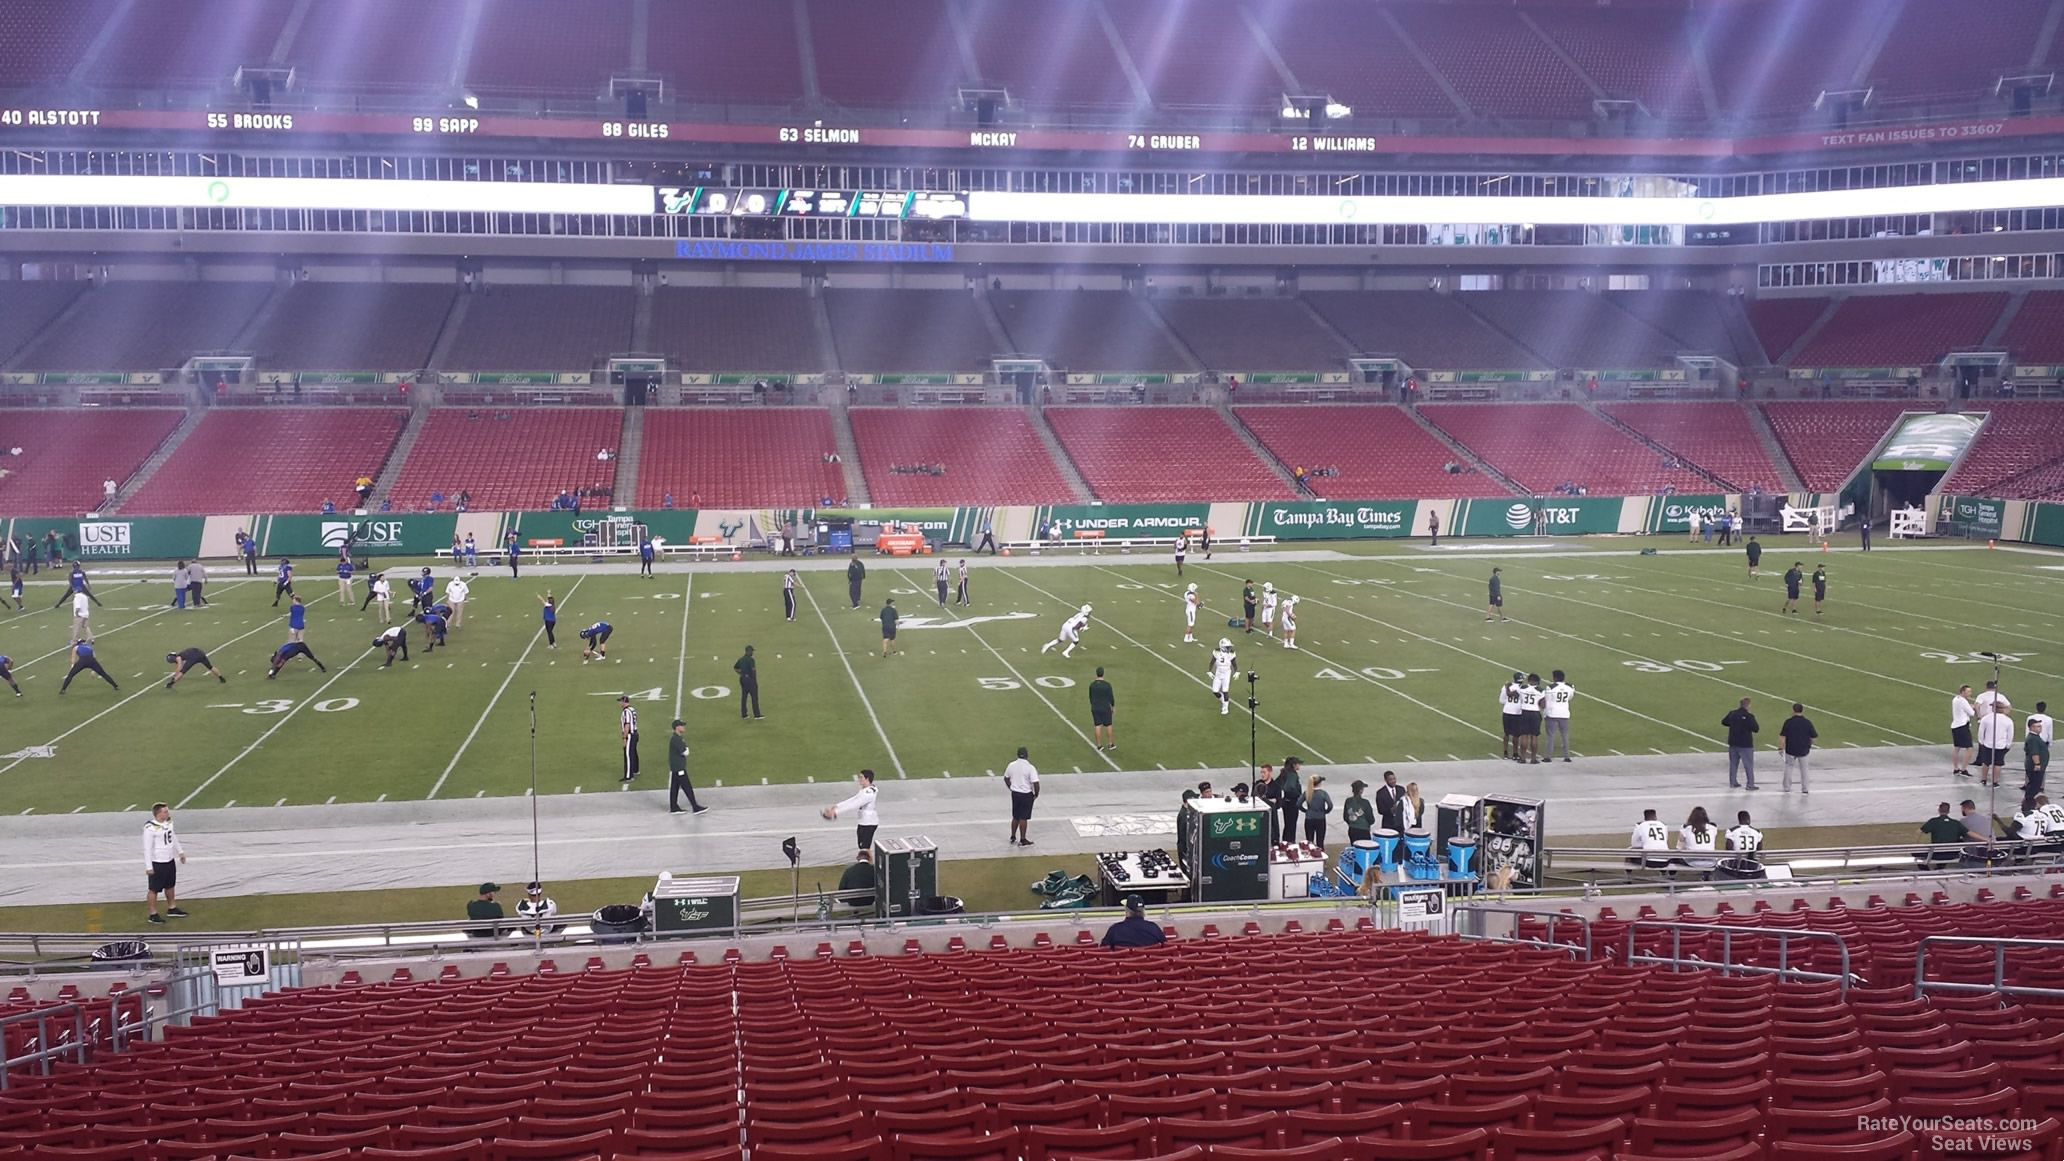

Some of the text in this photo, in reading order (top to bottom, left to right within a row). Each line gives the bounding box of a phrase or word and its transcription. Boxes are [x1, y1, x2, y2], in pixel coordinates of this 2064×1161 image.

[1, 110, 100, 125] 40 ALSTOTT
[207, 113, 293, 129] 55 BROOKS
[413, 118, 478, 133] 99 SAPP
[602, 122, 669, 138] 88 GILES
[780, 128, 859, 143] 63 SELMON
[1128, 135, 1200, 149] 74 GRUBER
[1822, 124, 2003, 146] TEXT FAN ISSUES TO 33607
[1292, 137, 1376, 151] 12 WILLIAMS
[675, 240, 953, 261] RAYMOND JAMES STADIUM
[1960, 504, 1977, 514] TGH
[576, 519, 600, 529] TGH
[606, 515, 633, 523] Tampa
[1075, 519, 1129, 529] UNDER
[1273, 507, 1402, 529] Tampa Bay Times
[83, 525, 127, 543] USF
[350, 521, 403, 542] USF
[81, 545, 130, 555] HEALTH
[976, 675, 1076, 690] 50
[1524, 693, 1536, 705] 35
[1556, 692, 1569, 703] 92
[242, 697, 360, 714] 30
[1648, 827, 1665, 841] 45
[2034, 820, 2046, 836] 75
[1739, 835, 1755, 850] 33
[1223, 854, 1259, 862] CoachComm
[216, 954, 247, 962] WARNING
